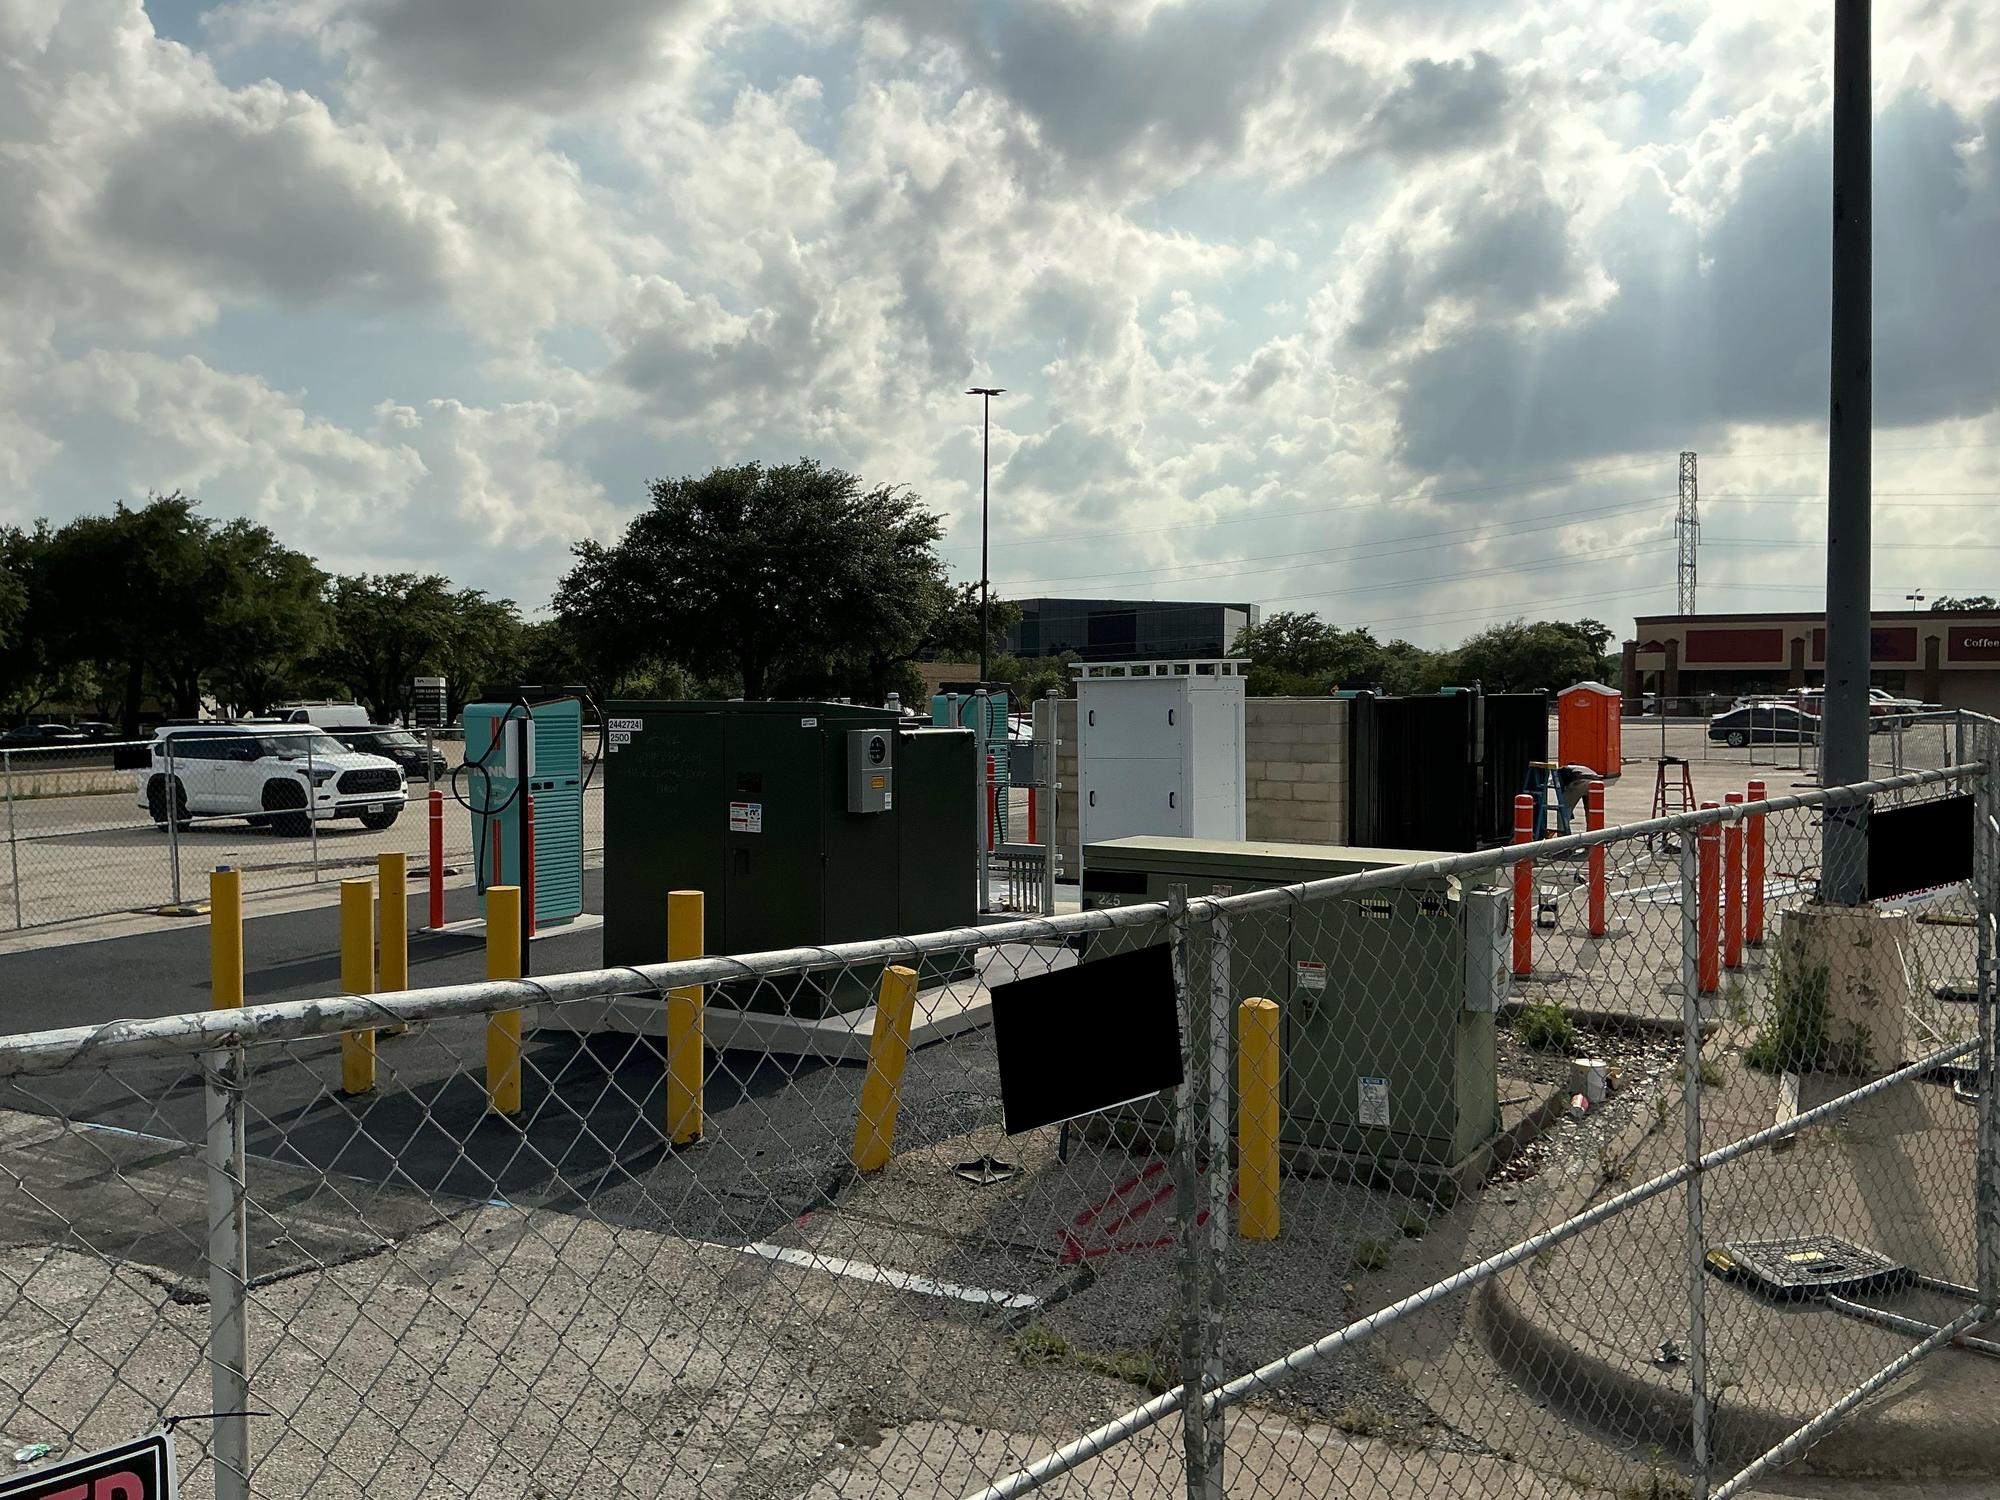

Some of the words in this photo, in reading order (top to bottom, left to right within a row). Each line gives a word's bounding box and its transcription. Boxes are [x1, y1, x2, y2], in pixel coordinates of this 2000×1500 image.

[1964, 638, 2000, 648] Coffee
[610, 733, 629, 742] 2500
[1098, 894, 1121, 907] 225
